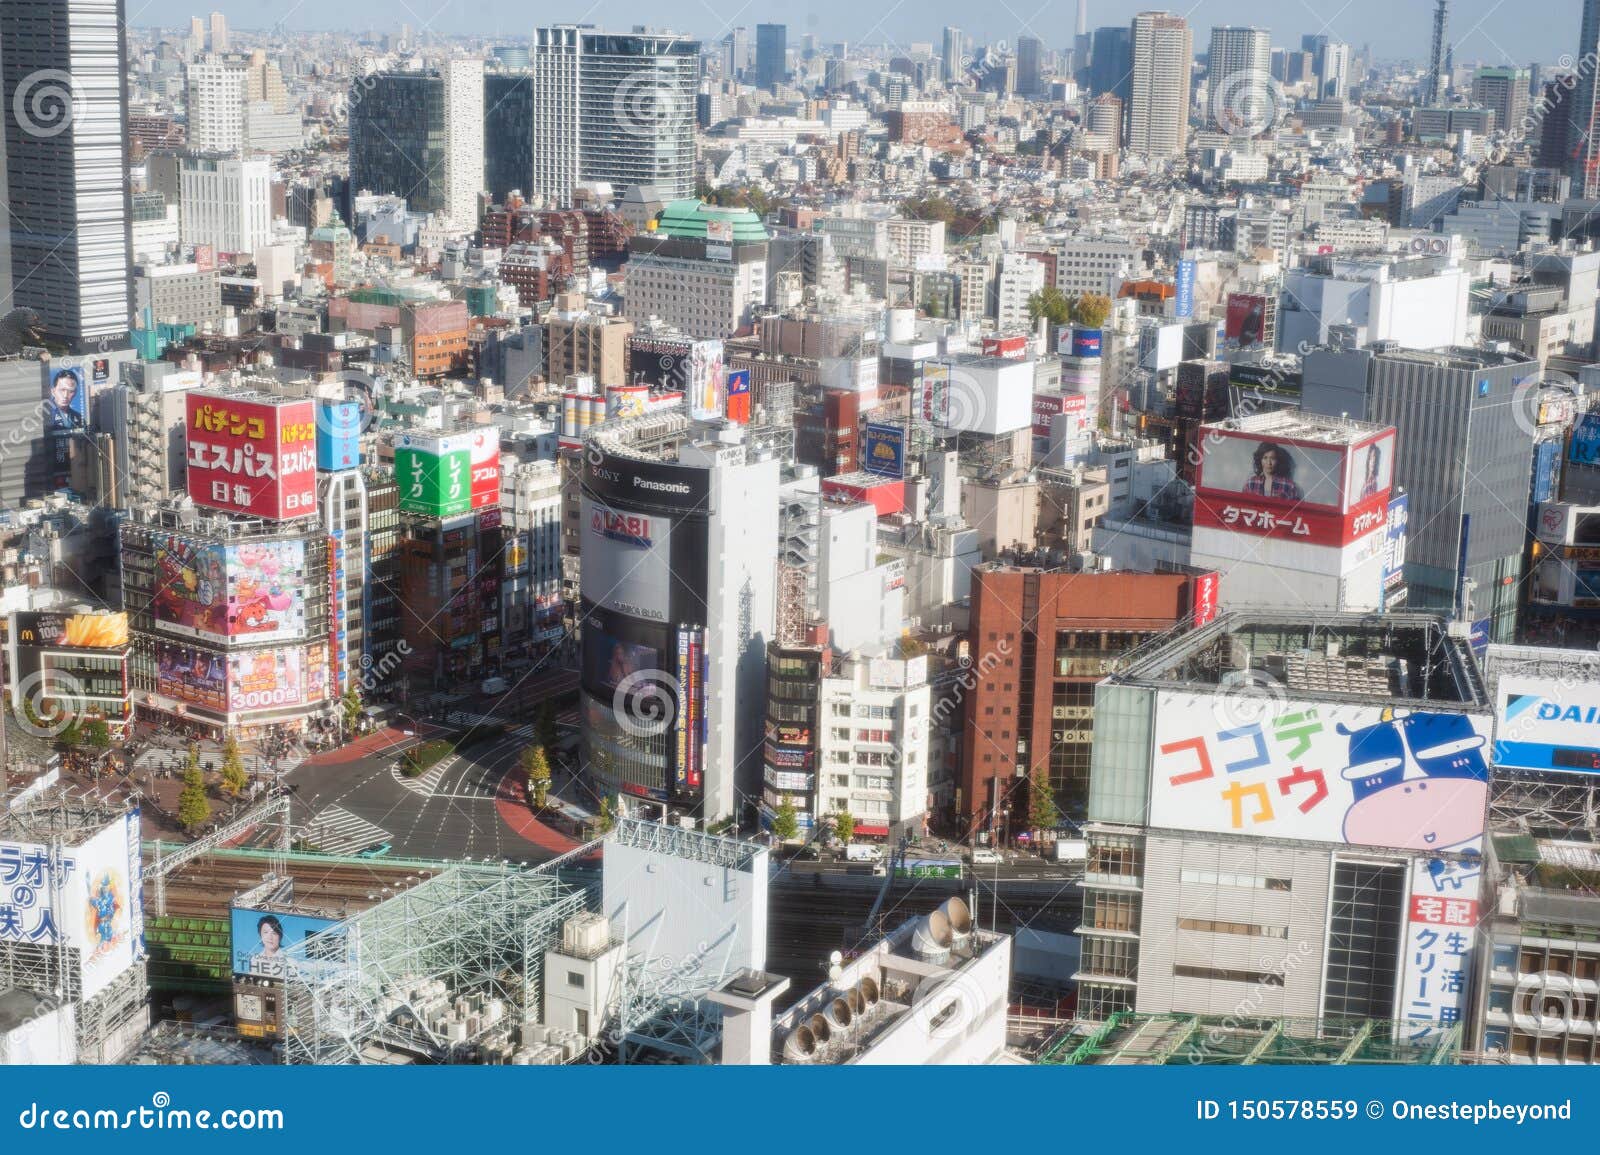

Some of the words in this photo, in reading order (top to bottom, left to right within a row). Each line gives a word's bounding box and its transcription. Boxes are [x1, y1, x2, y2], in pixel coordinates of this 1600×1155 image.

[194, 404, 266, 440] パチンコ
[281, 422, 315, 444] パチンコ
[188, 440, 278, 481] エスパス
[281, 444, 316, 476] エスパス
[411, 453, 424, 498] レイク
[472, 467, 498, 483] アコム
[592, 466, 621, 482] SONY
[449, 455, 462, 499] レイク
[633, 476, 690, 494] Panasonic
[604, 511, 650, 539] LABI
[1221, 504, 1311, 537] タマホーム
[1352, 505, 1384, 536] タマホーム
[1536, 702, 1600, 725] DAI
[1159, 707, 1325, 788] ココデ
[1221, 764, 1330, 829] カウ
[11, 882, 37, 909] の
[1416, 897, 1472, 925] 宅配
[1408, 928, 1440, 1041] クリーニン
